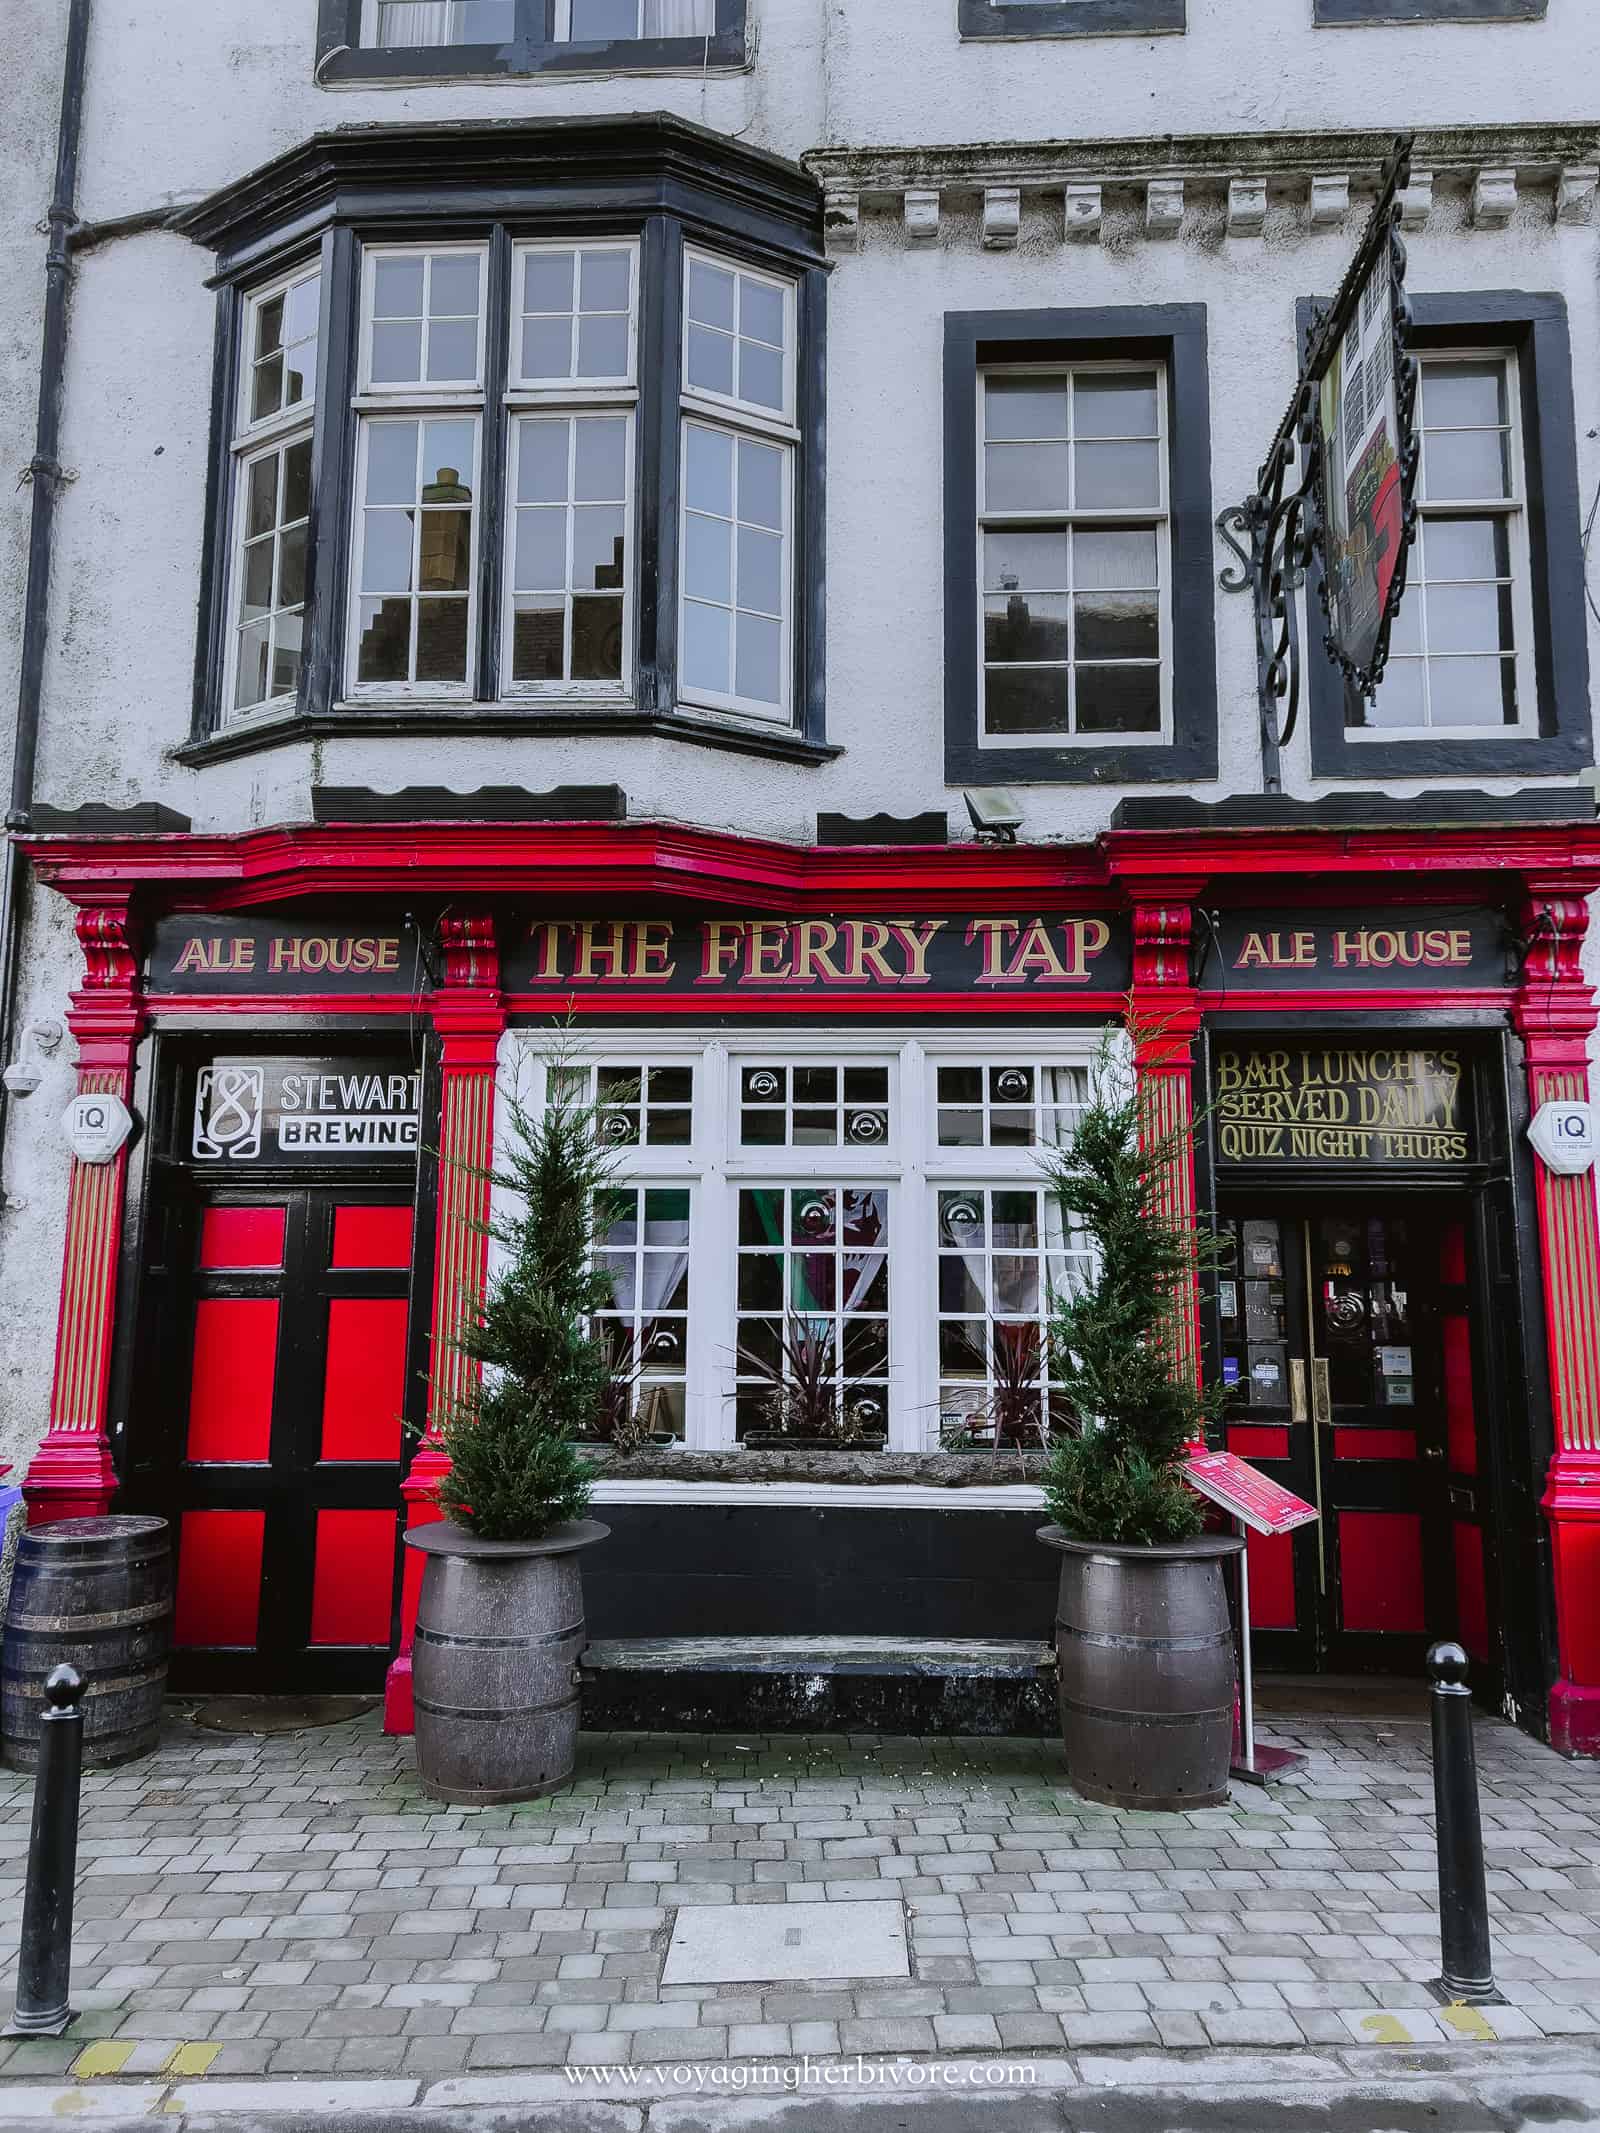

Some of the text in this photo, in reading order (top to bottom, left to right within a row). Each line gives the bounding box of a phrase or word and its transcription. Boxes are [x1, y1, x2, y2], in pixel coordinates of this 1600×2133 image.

[171, 938, 400, 973] ALE HOUSE
[529, 918, 1110, 984] THE FERRY TAP
[1232, 930, 1472, 968] ALE HOUSE
[1218, 1049, 1460, 1090] BAR LUNCHES
[280, 1075, 421, 1110] STEWART
[1220, 1078, 1458, 1129] SERVED DAILY
[79, 1107, 105, 1129] iQ
[284, 1121, 418, 1144] BREWING
[1557, 1115, 1585, 1138] iQ
[1221, 1125, 1467, 1160] QUIZ NIGHT THURS
